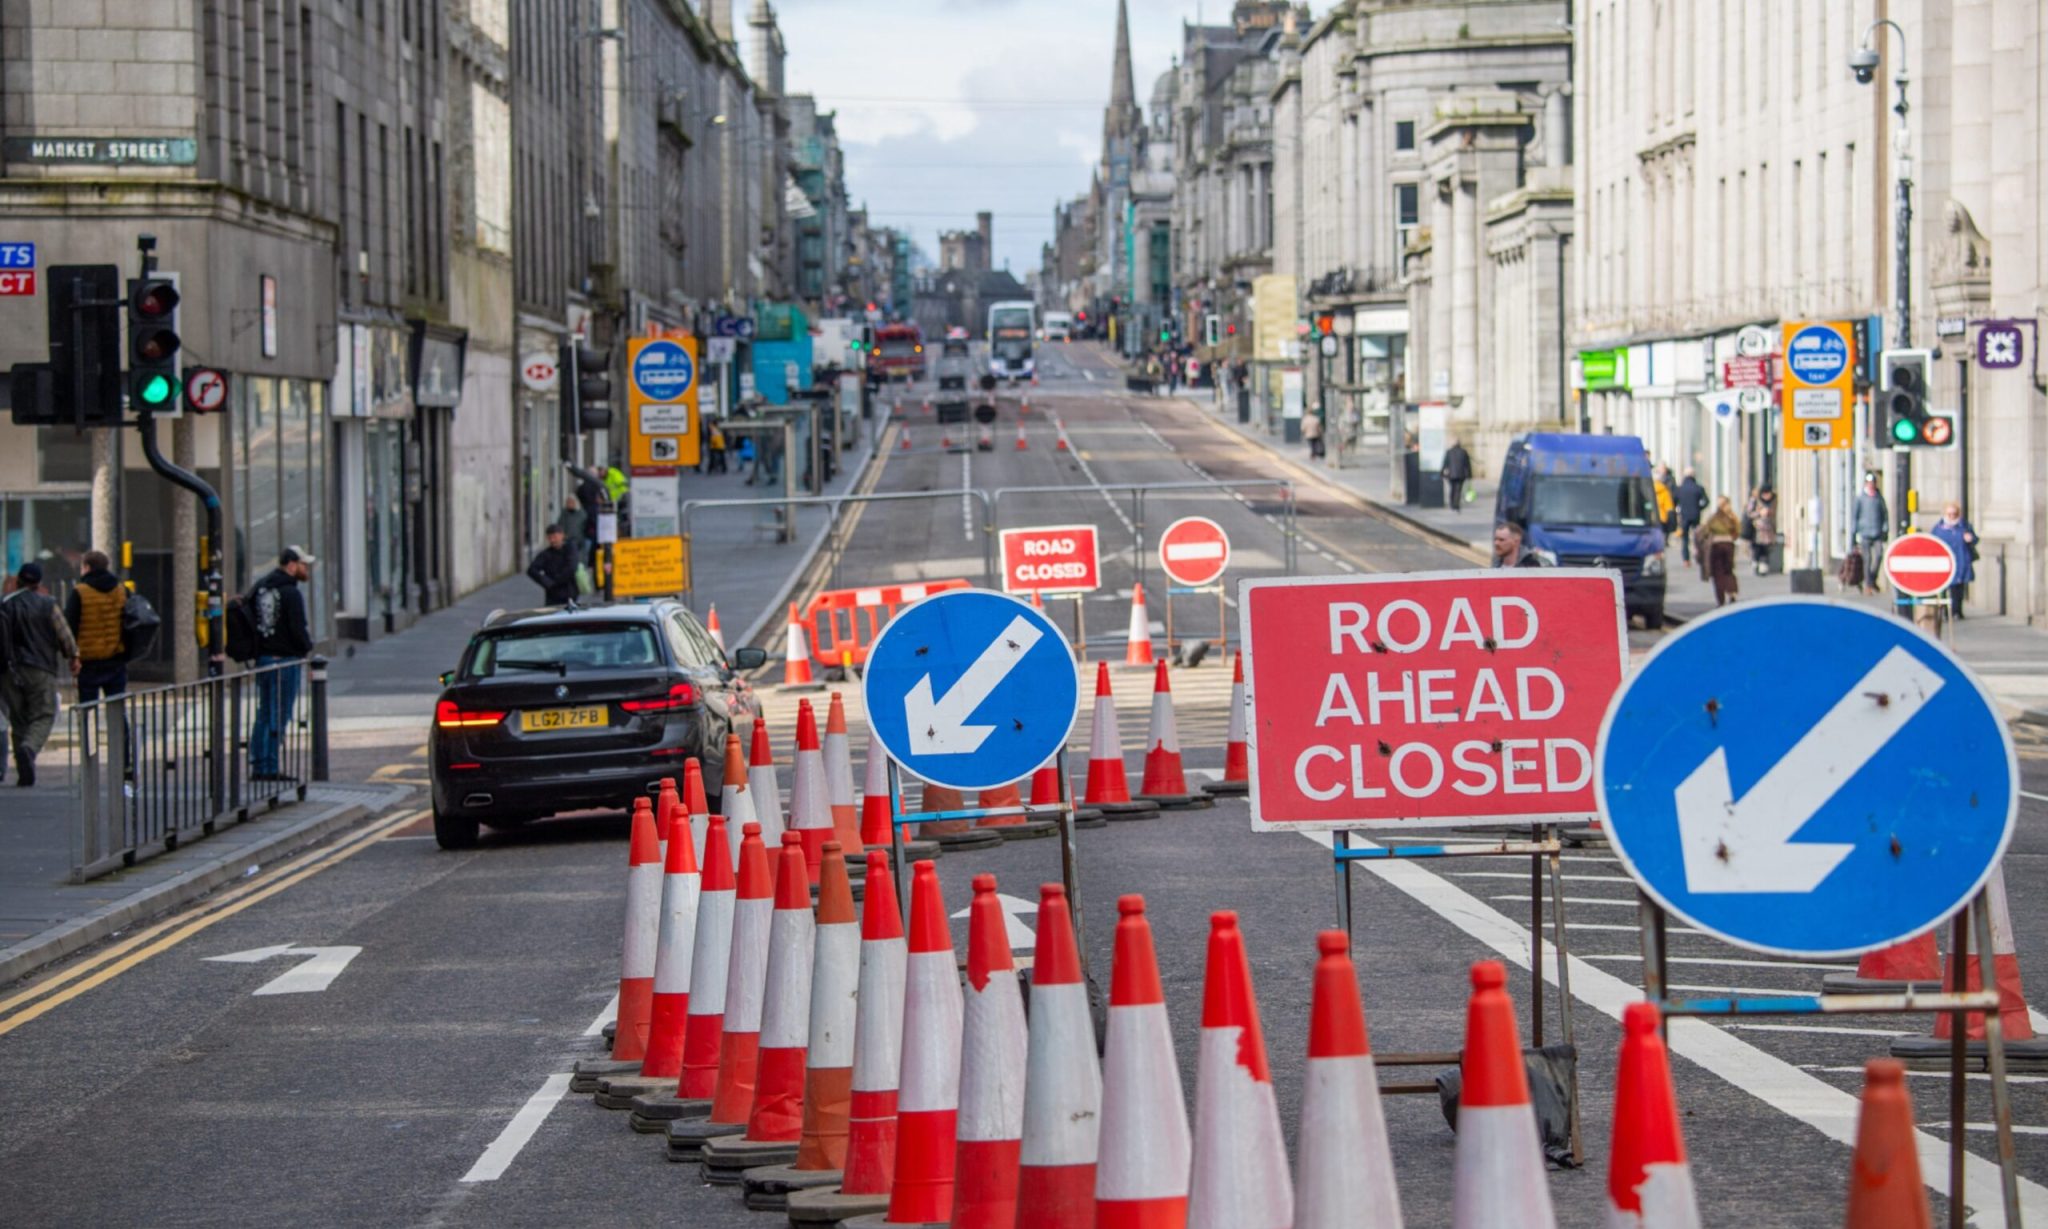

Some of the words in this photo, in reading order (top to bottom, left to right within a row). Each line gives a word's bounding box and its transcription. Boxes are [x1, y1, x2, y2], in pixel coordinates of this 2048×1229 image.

[32, 142, 95, 158] MARKET
[1, 245, 31, 265] TS
[0, 273, 32, 293] CT
[1023, 537, 1076, 557] ROAD
[1015, 561, 1088, 582] CLOSED
[1327, 595, 1540, 655] ROAD
[1314, 666, 1566, 727] AHEAD
[530, 711, 566, 728] LG21
[568, 708, 599, 725] ZFB
[1293, 737, 1594, 802] CLOSED
